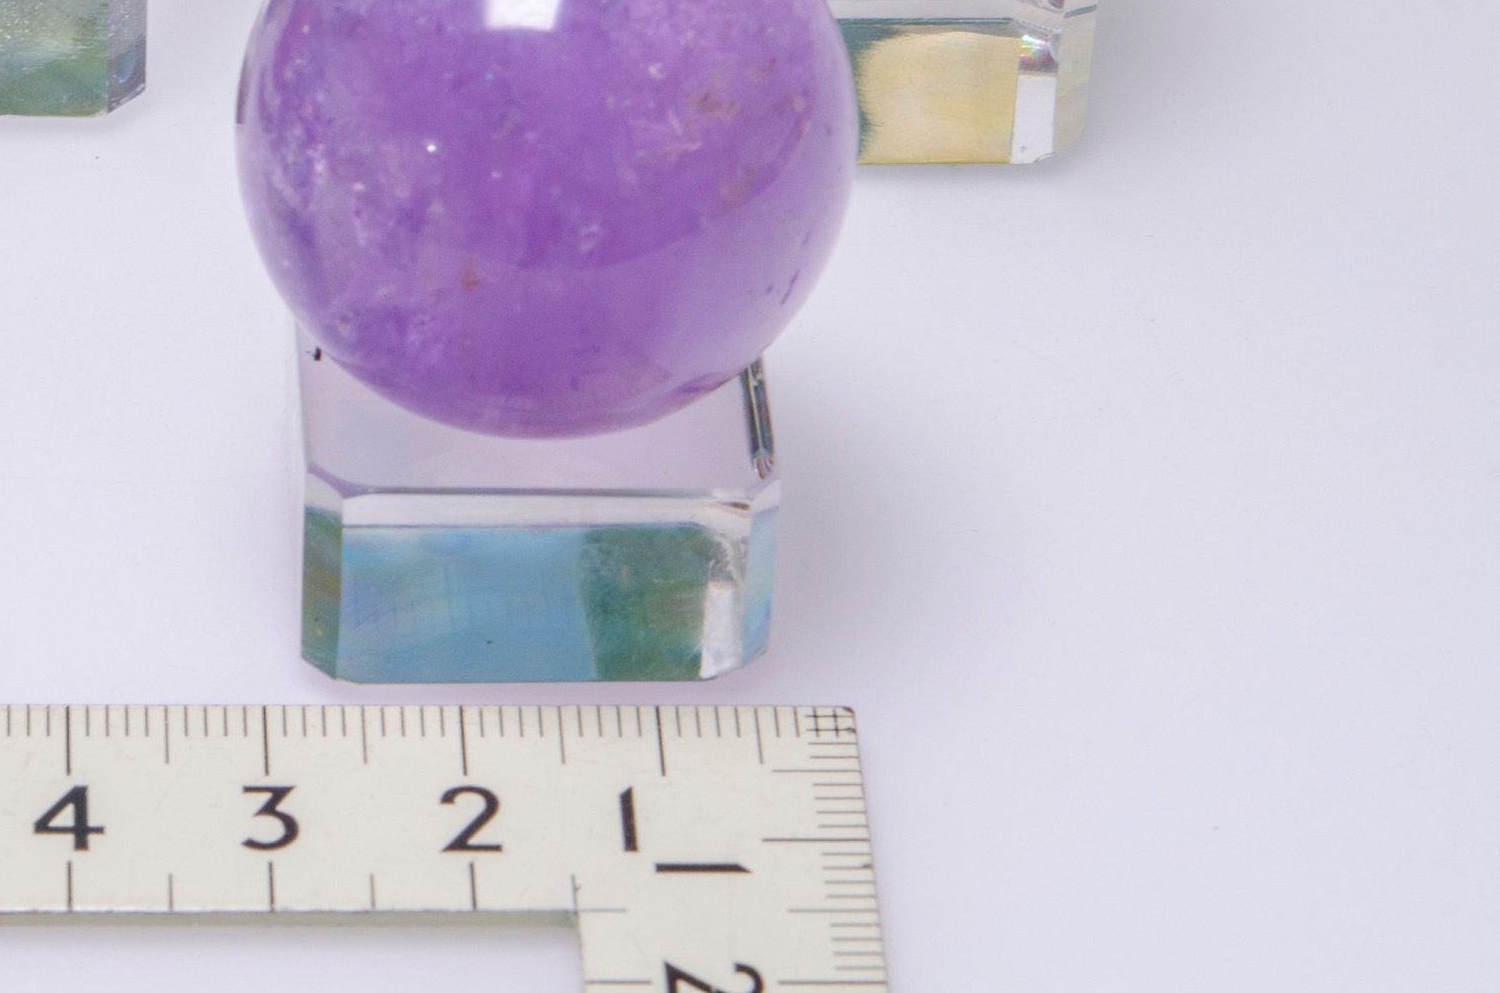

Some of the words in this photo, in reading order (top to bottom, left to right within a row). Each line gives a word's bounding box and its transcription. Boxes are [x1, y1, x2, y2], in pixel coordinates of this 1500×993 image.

[34, 786, 104, 850] 4
[242, 786, 299, 851] 3
[440, 786, 503, 852] 2
[619, 786, 639, 852] 1
